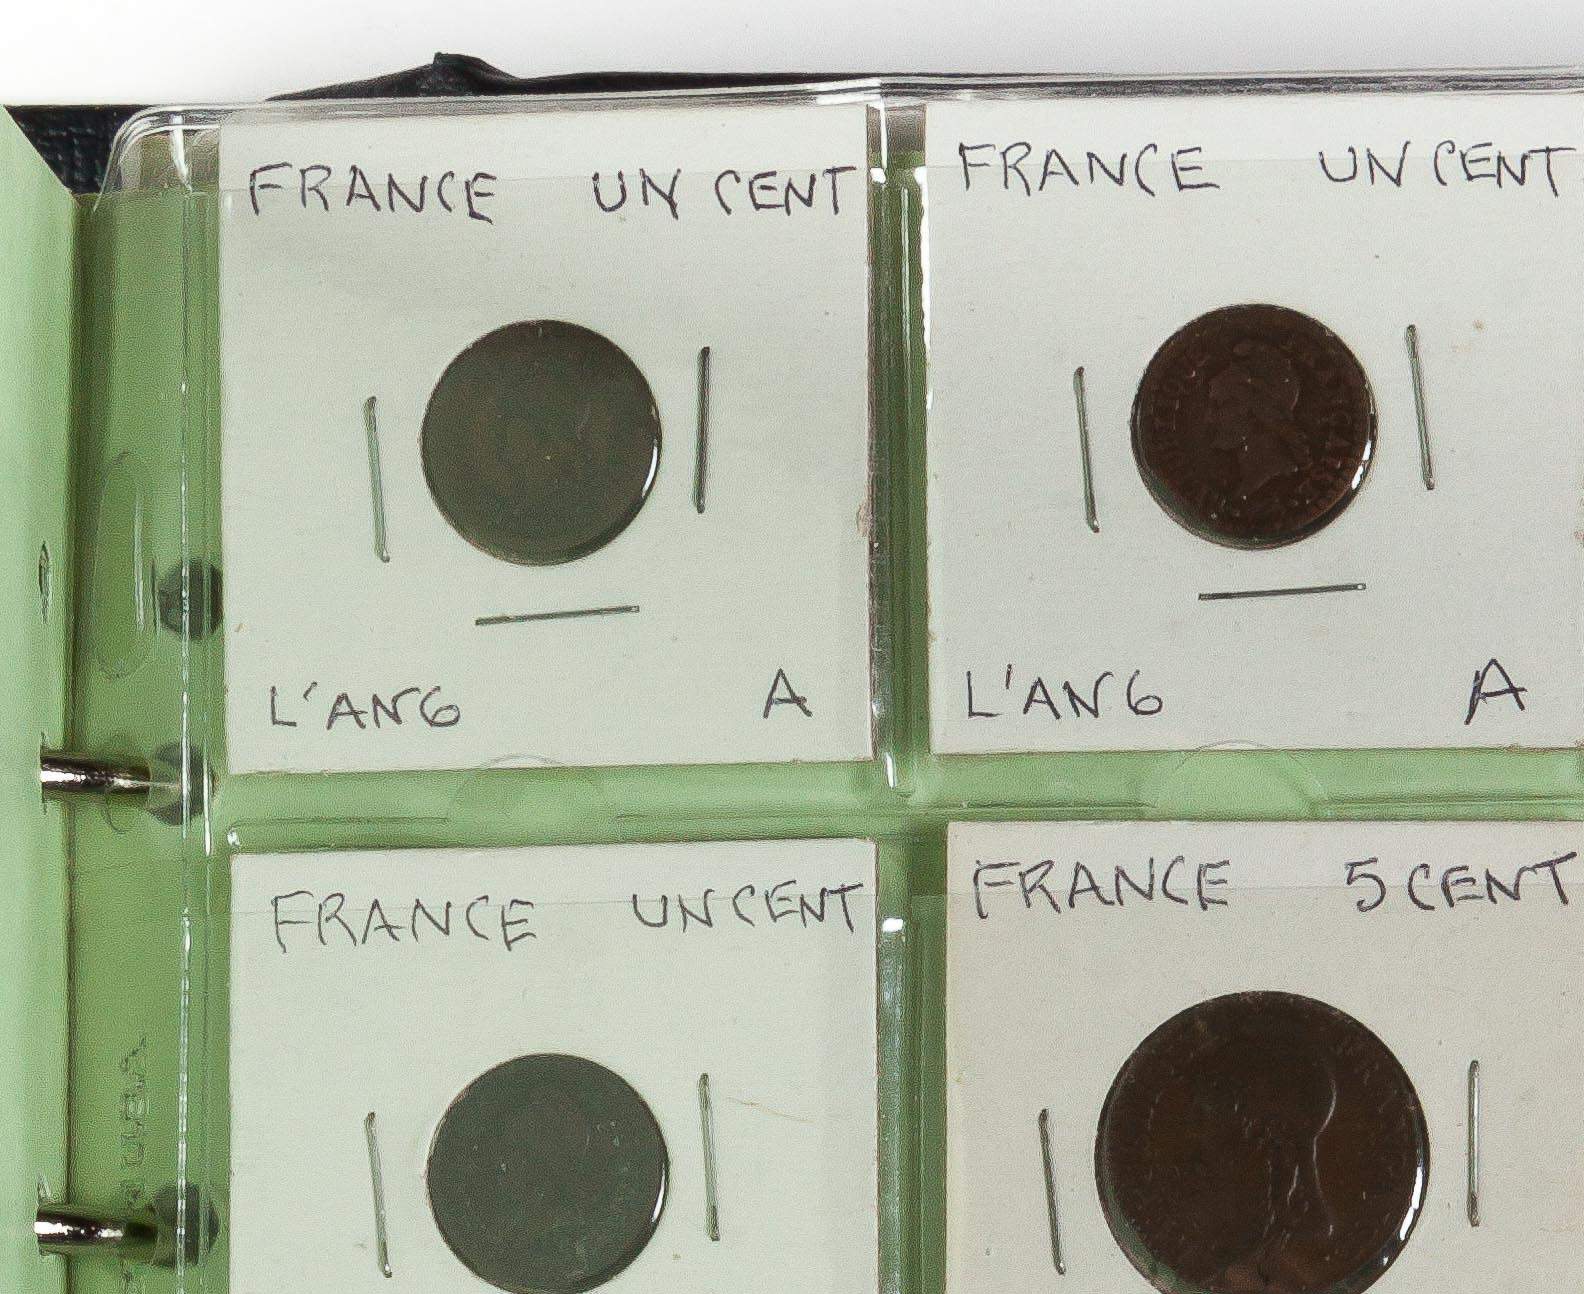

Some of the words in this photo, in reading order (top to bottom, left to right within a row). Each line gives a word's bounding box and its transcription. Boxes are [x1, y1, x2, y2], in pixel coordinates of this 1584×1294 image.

[248, 161, 498, 225] FRANCE
[591, 167, 682, 221] UN
[713, 165, 858, 217] CENT
[957, 140, 1221, 198] FRANCE
[1318, 140, 1412, 188] UN
[1433, 139, 1577, 198] CENT
[762, 667, 813, 720] A
[1463, 657, 1528, 726] A
[270, 889, 537, 954] FRANCE
[630, 888, 715, 933] UN
[731, 879, 864, 934] CENT
[972, 855, 1230, 920] FRANCE
[1344, 856, 1387, 913] 5
[1406, 851, 1578, 912] CENT
